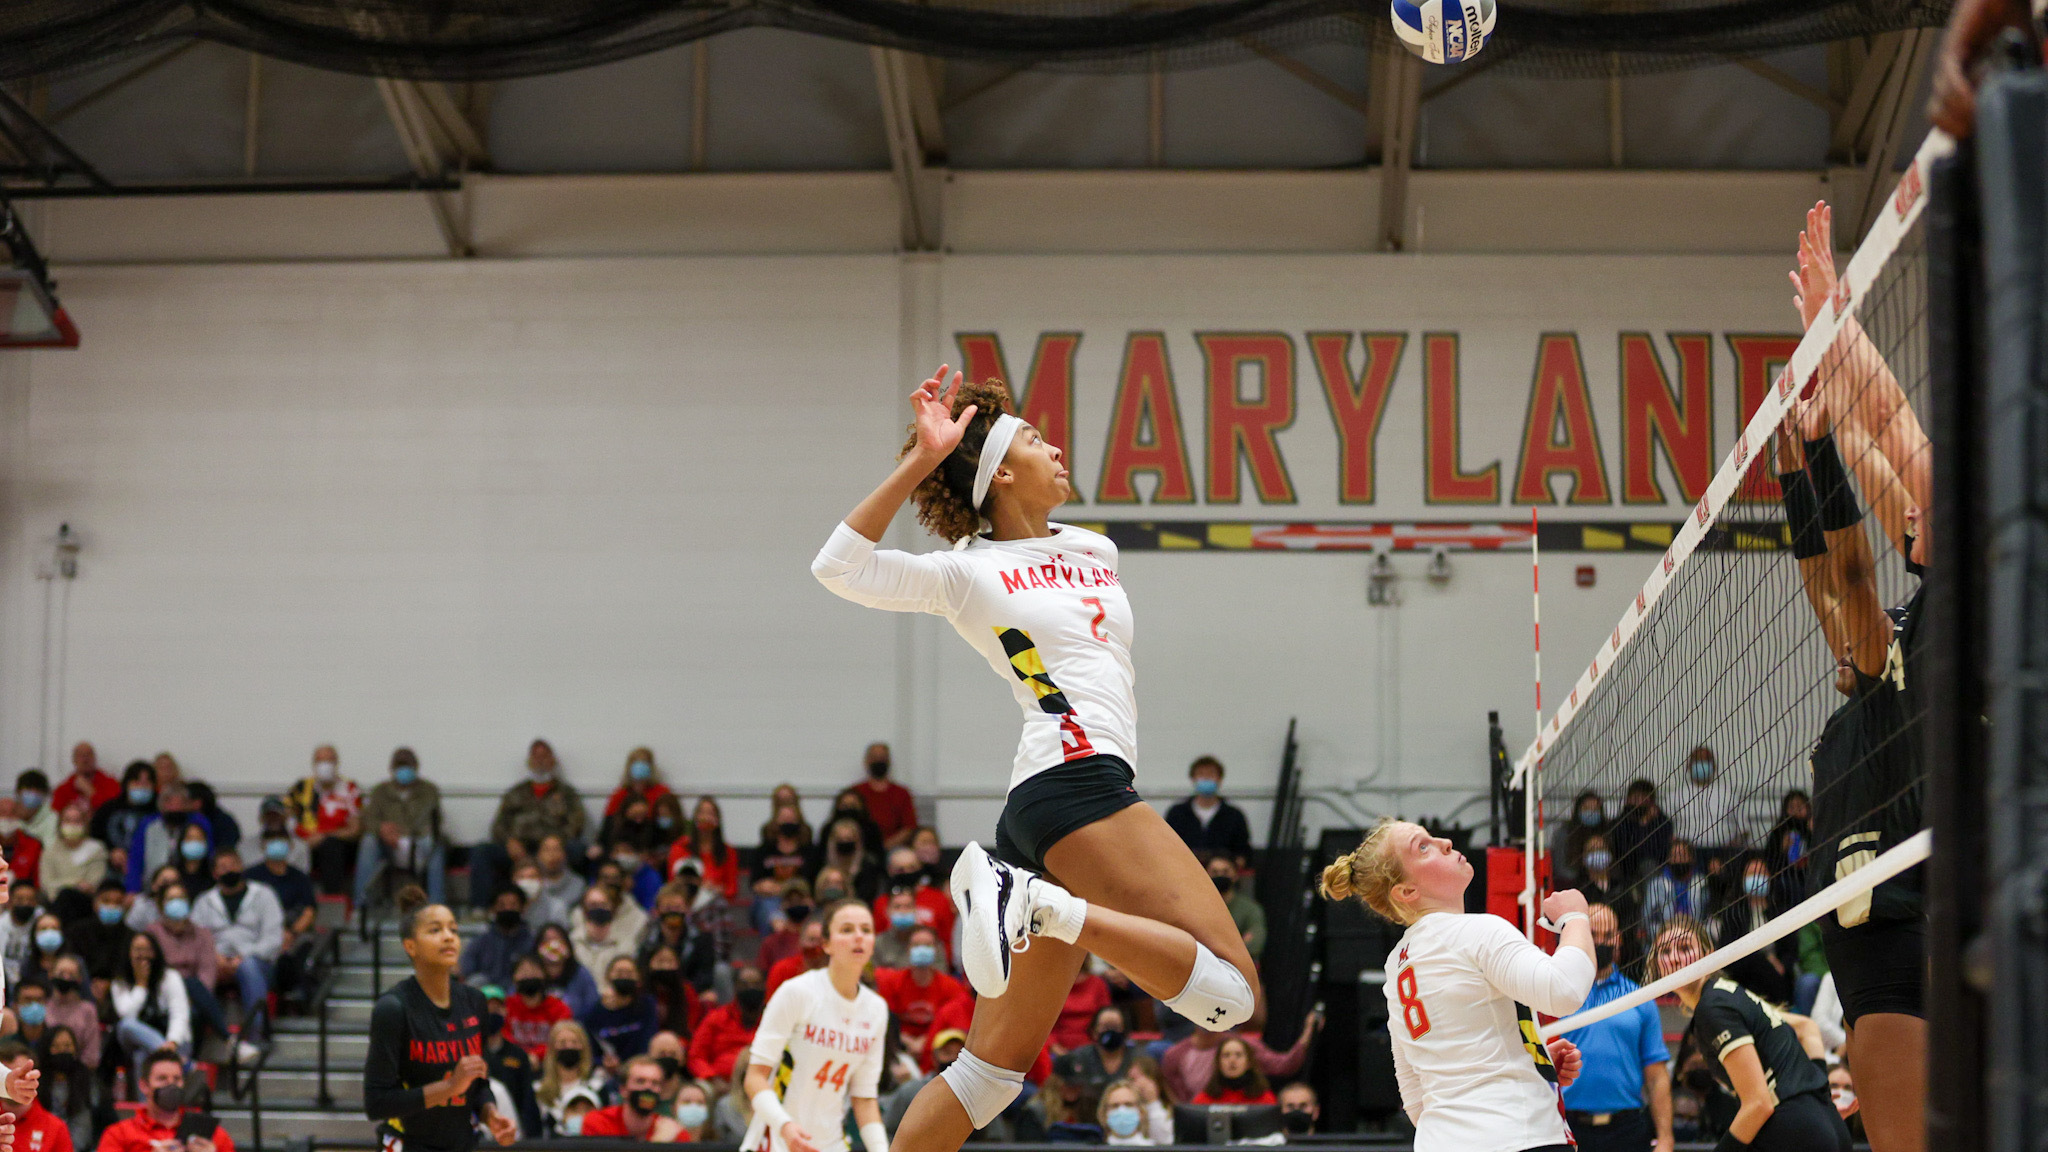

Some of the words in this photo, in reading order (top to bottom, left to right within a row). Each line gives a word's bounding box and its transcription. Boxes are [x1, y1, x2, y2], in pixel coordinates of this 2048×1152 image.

[1449, 19, 1464, 59] NCAA
[1466, 5, 1481, 55] molten
[999, 563, 1121, 595] MARYLAN
[1080, 596, 1110, 644] 2
[1397, 964, 1432, 1042] 8
[803, 1023, 876, 1055] MARYLAN
[813, 1059, 850, 1093] 44
